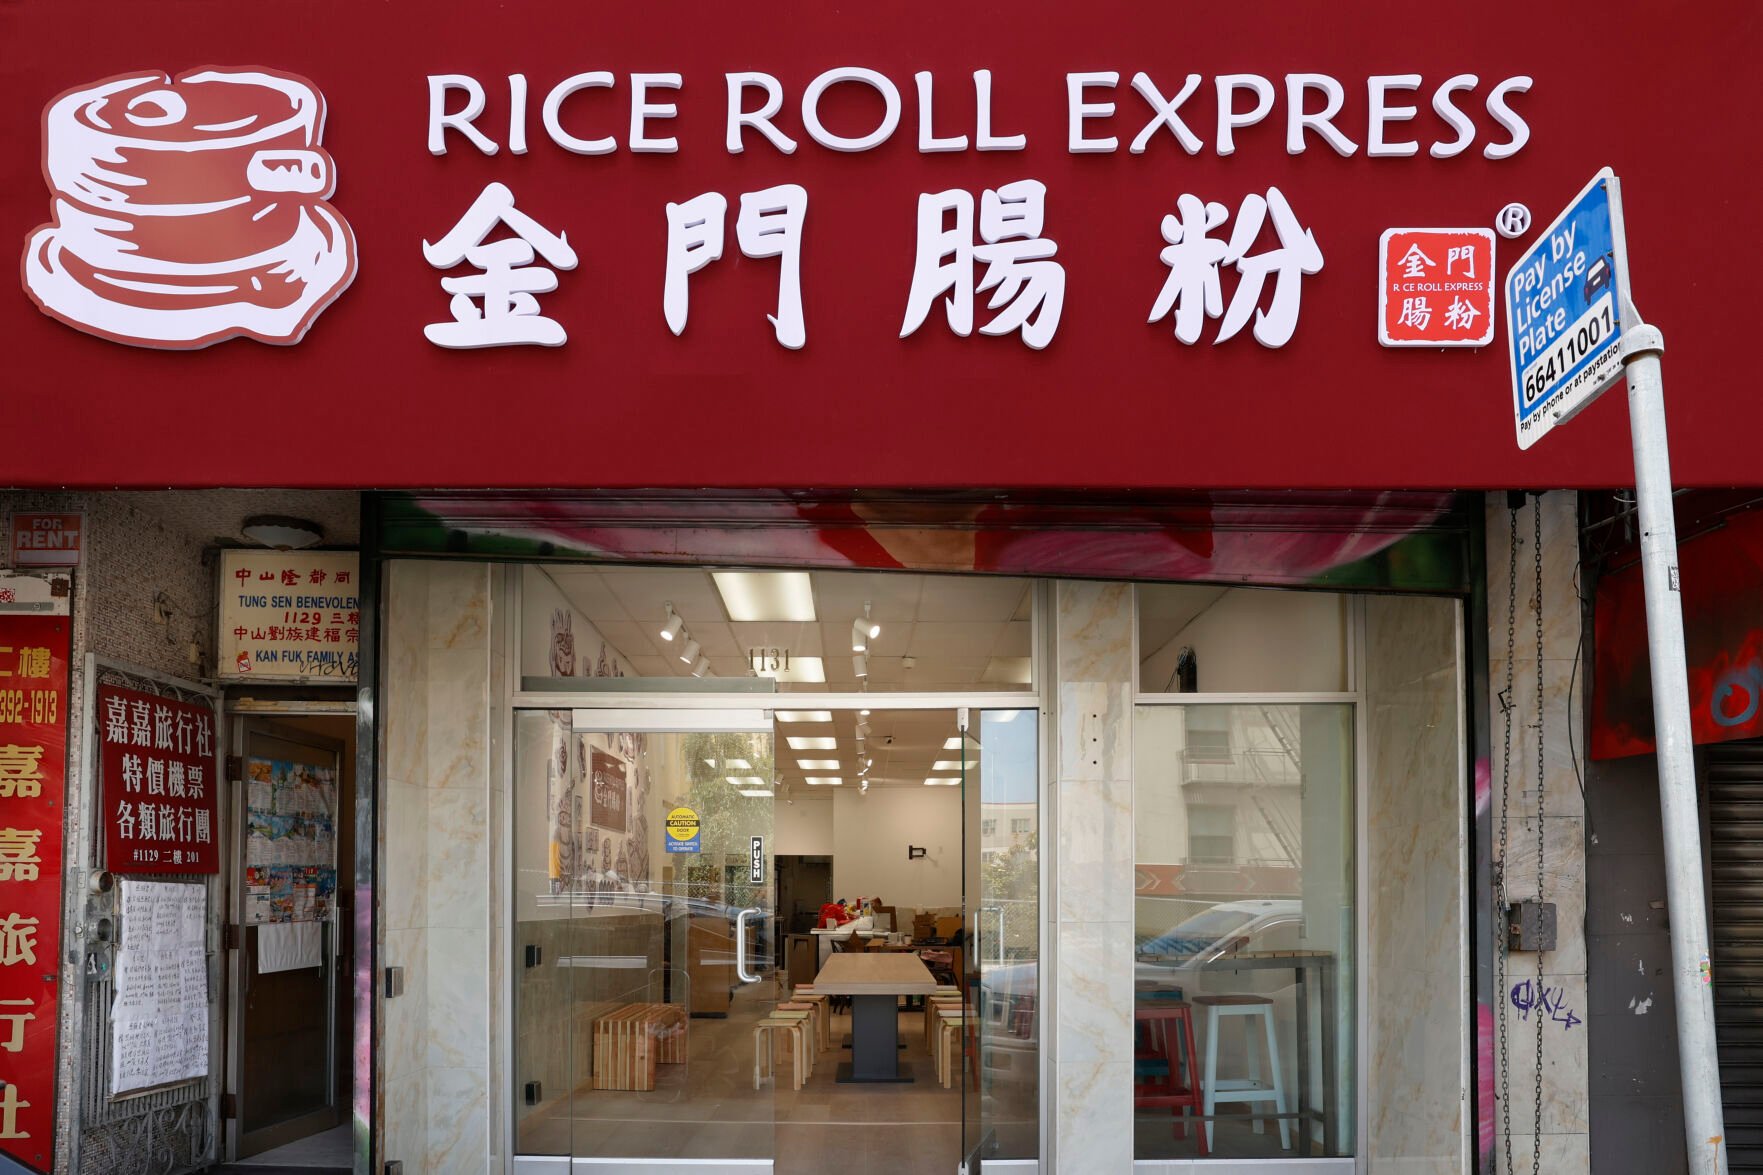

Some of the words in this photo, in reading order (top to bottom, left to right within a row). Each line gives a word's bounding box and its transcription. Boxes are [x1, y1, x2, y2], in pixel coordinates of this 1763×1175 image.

[427, 71, 682, 156] RICE
[725, 66, 1026, 154] ROLL
[1066, 71, 1533, 159] EXPRESS
[422, 181, 1324, 350] 金門腸粉
[1397, 243, 1475, 279] 金門
[1514, 253, 1546, 303] Pay
[1551, 220, 1576, 264] by
[1393, 283, 1415, 292] RCE
[1417, 282, 1443, 292] ROLL
[1444, 282, 1484, 291] EXPRESS
[1516, 251, 1586, 335] License
[1397, 295, 1482, 331] 腸粉
[1519, 307, 1566, 366] Plate
[1525, 305, 1612, 402] 66411001
[1520, 418, 1532, 433] Pay
[1533, 409, 1541, 423] by
[1542, 391, 1564, 417] phone
[1565, 382, 1573, 395] or
[1574, 375, 1583, 388] at
[16, 530, 79, 548] RENT
[32, 518, 63, 529] FOR
[238, 595, 267, 607] TUNG
[271, 596, 292, 608] SEN
[296, 596, 360, 609] BENEVOLEN
[284, 611, 321, 625] 1129
[255, 649, 278, 662] KAN
[282, 649, 303, 662] FUK
[306, 650, 344, 664] FAMILY
[749, 648, 791, 673] 1131
[0, 690, 58, 723] 392-1913
[105, 695, 213, 758] 嘉嘉旅行社
[122, 753, 204, 799] 特價機票
[116, 800, 212, 844] 各類旅行團
[133, 848, 159, 863] #1129
[163, 849, 183, 864] 二樓
[186, 851, 200, 863] 201
[753, 840, 761, 878] PUSH
